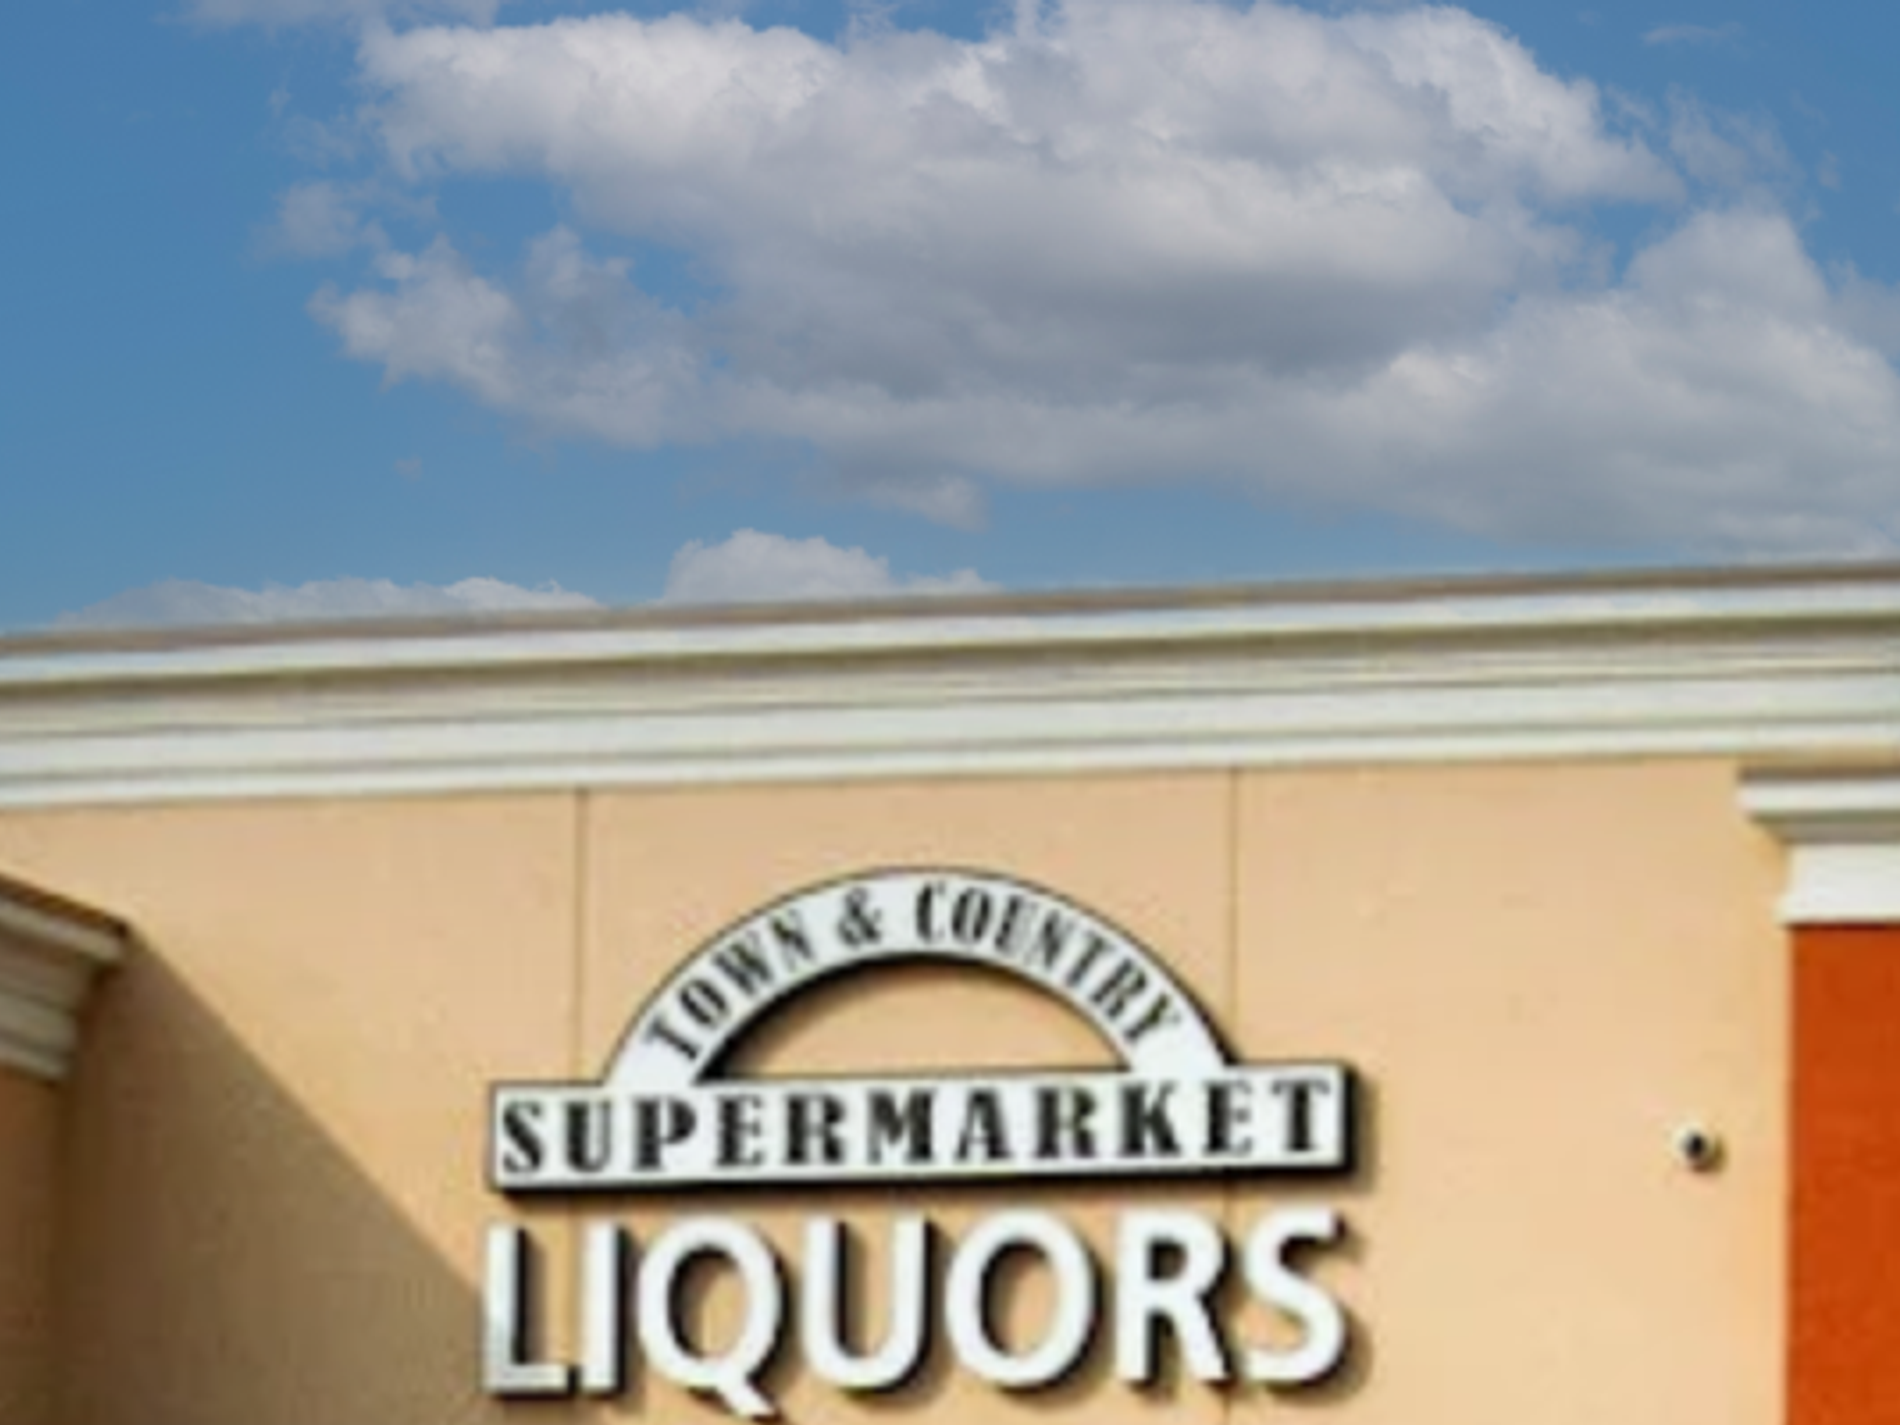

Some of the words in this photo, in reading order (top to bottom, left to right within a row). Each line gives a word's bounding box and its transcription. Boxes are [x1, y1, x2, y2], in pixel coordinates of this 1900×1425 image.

[642, 906, 817, 1065] TOWN
[836, 887, 884, 946] &
[914, 880, 1183, 1047] COUNTRY
[501, 1076, 1333, 1176] SUPERMARKET
[483, 1207, 1347, 1418] LIQUORS
